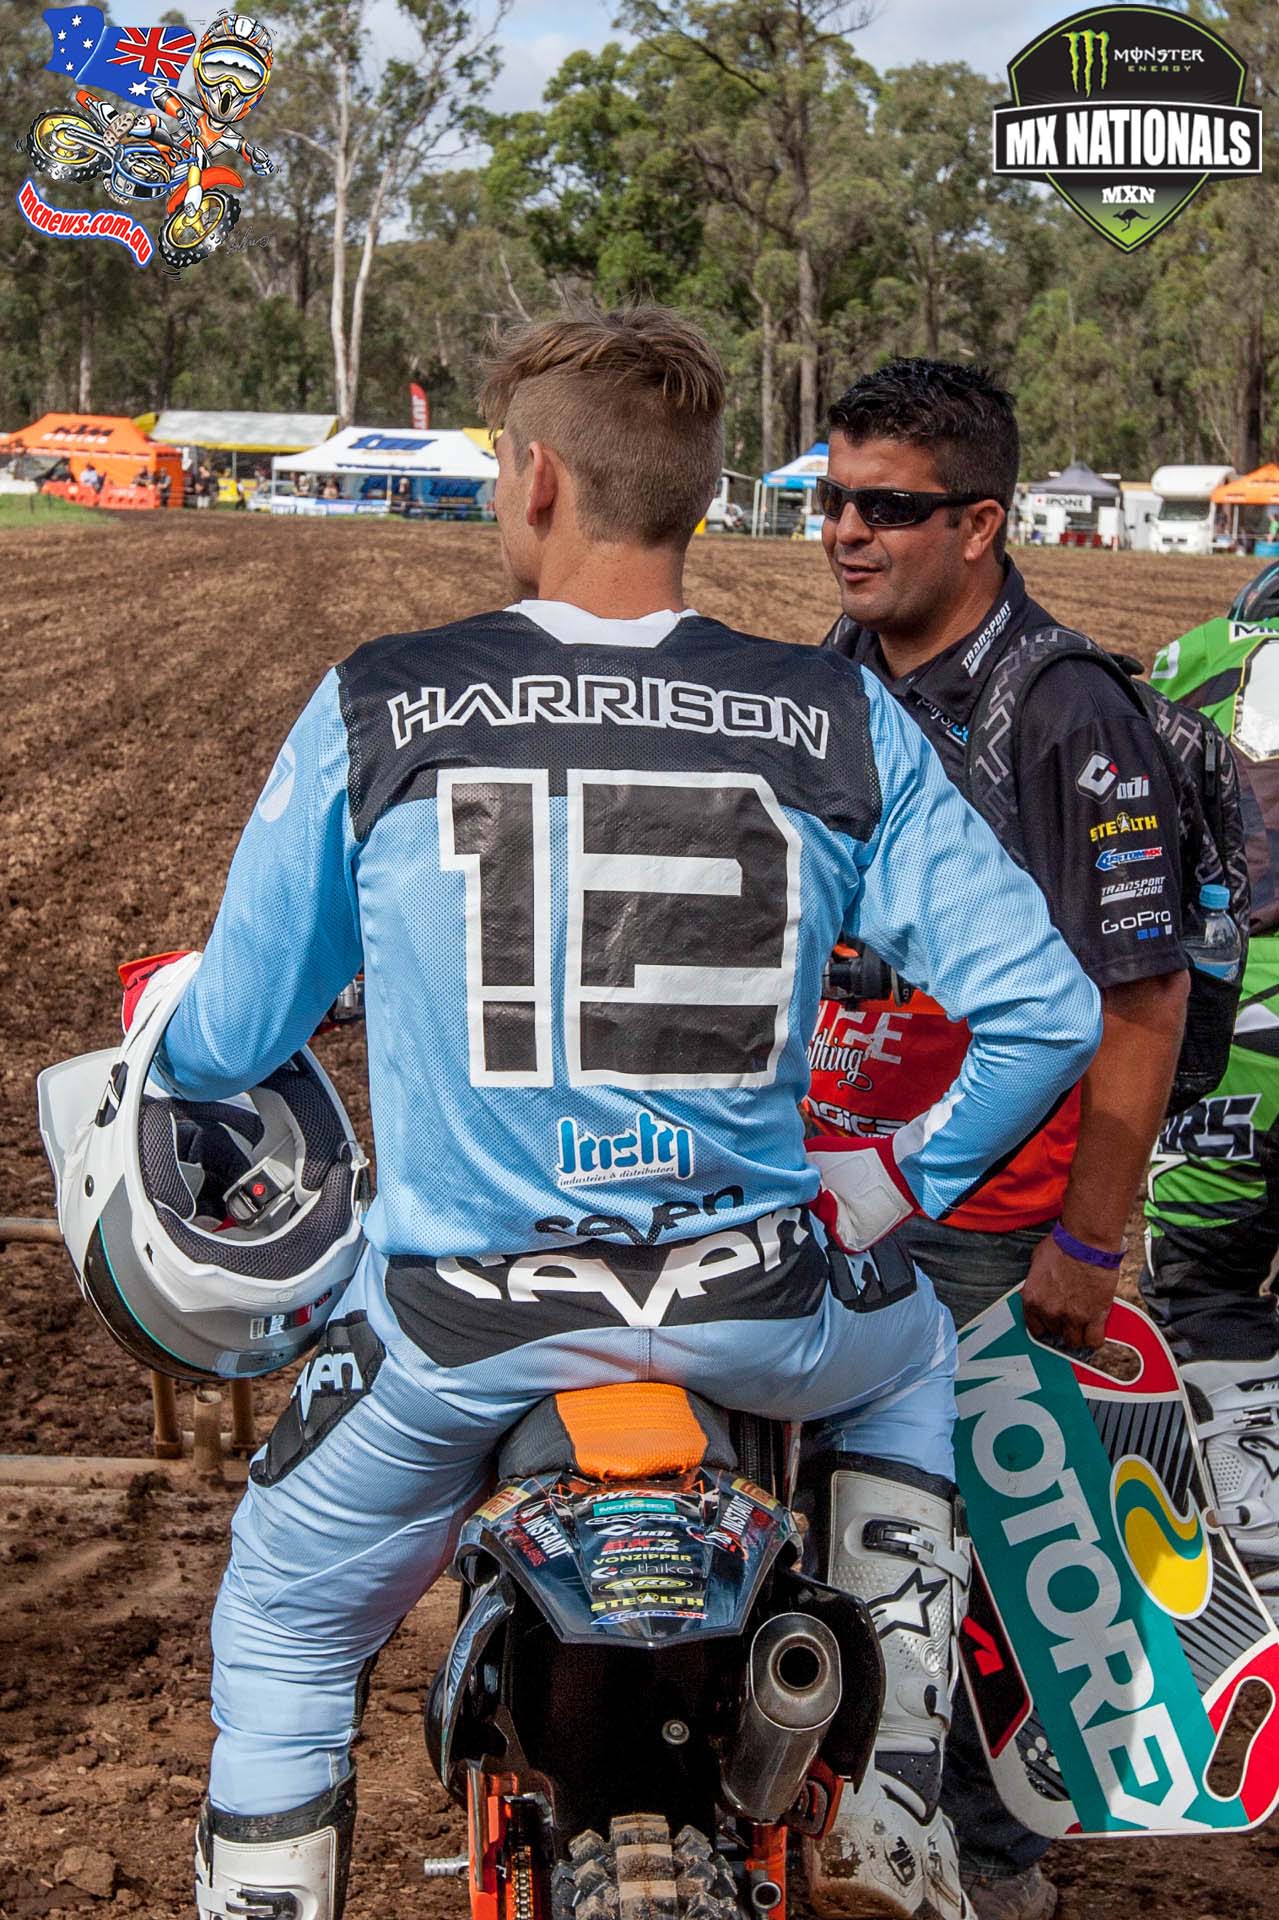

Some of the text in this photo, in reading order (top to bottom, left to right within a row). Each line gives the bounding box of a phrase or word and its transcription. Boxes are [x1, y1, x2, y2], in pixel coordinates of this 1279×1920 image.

[387, 674, 830, 760] HARRISON
[1089, 812, 1159, 843] STEALTH
[1135, 885, 1164, 897] 2000
[1101, 910, 1171, 935] GoPro
[560, 1174, 606, 1187] industries
[619, 1166, 675, 1178] distributors
[521, 1514, 575, 1559] INSTANT
[592, 1553, 693, 1566] VONZIPPER
[619, 1562, 695, 1575] ethika
[590, 1591, 705, 1613] STEALTH
